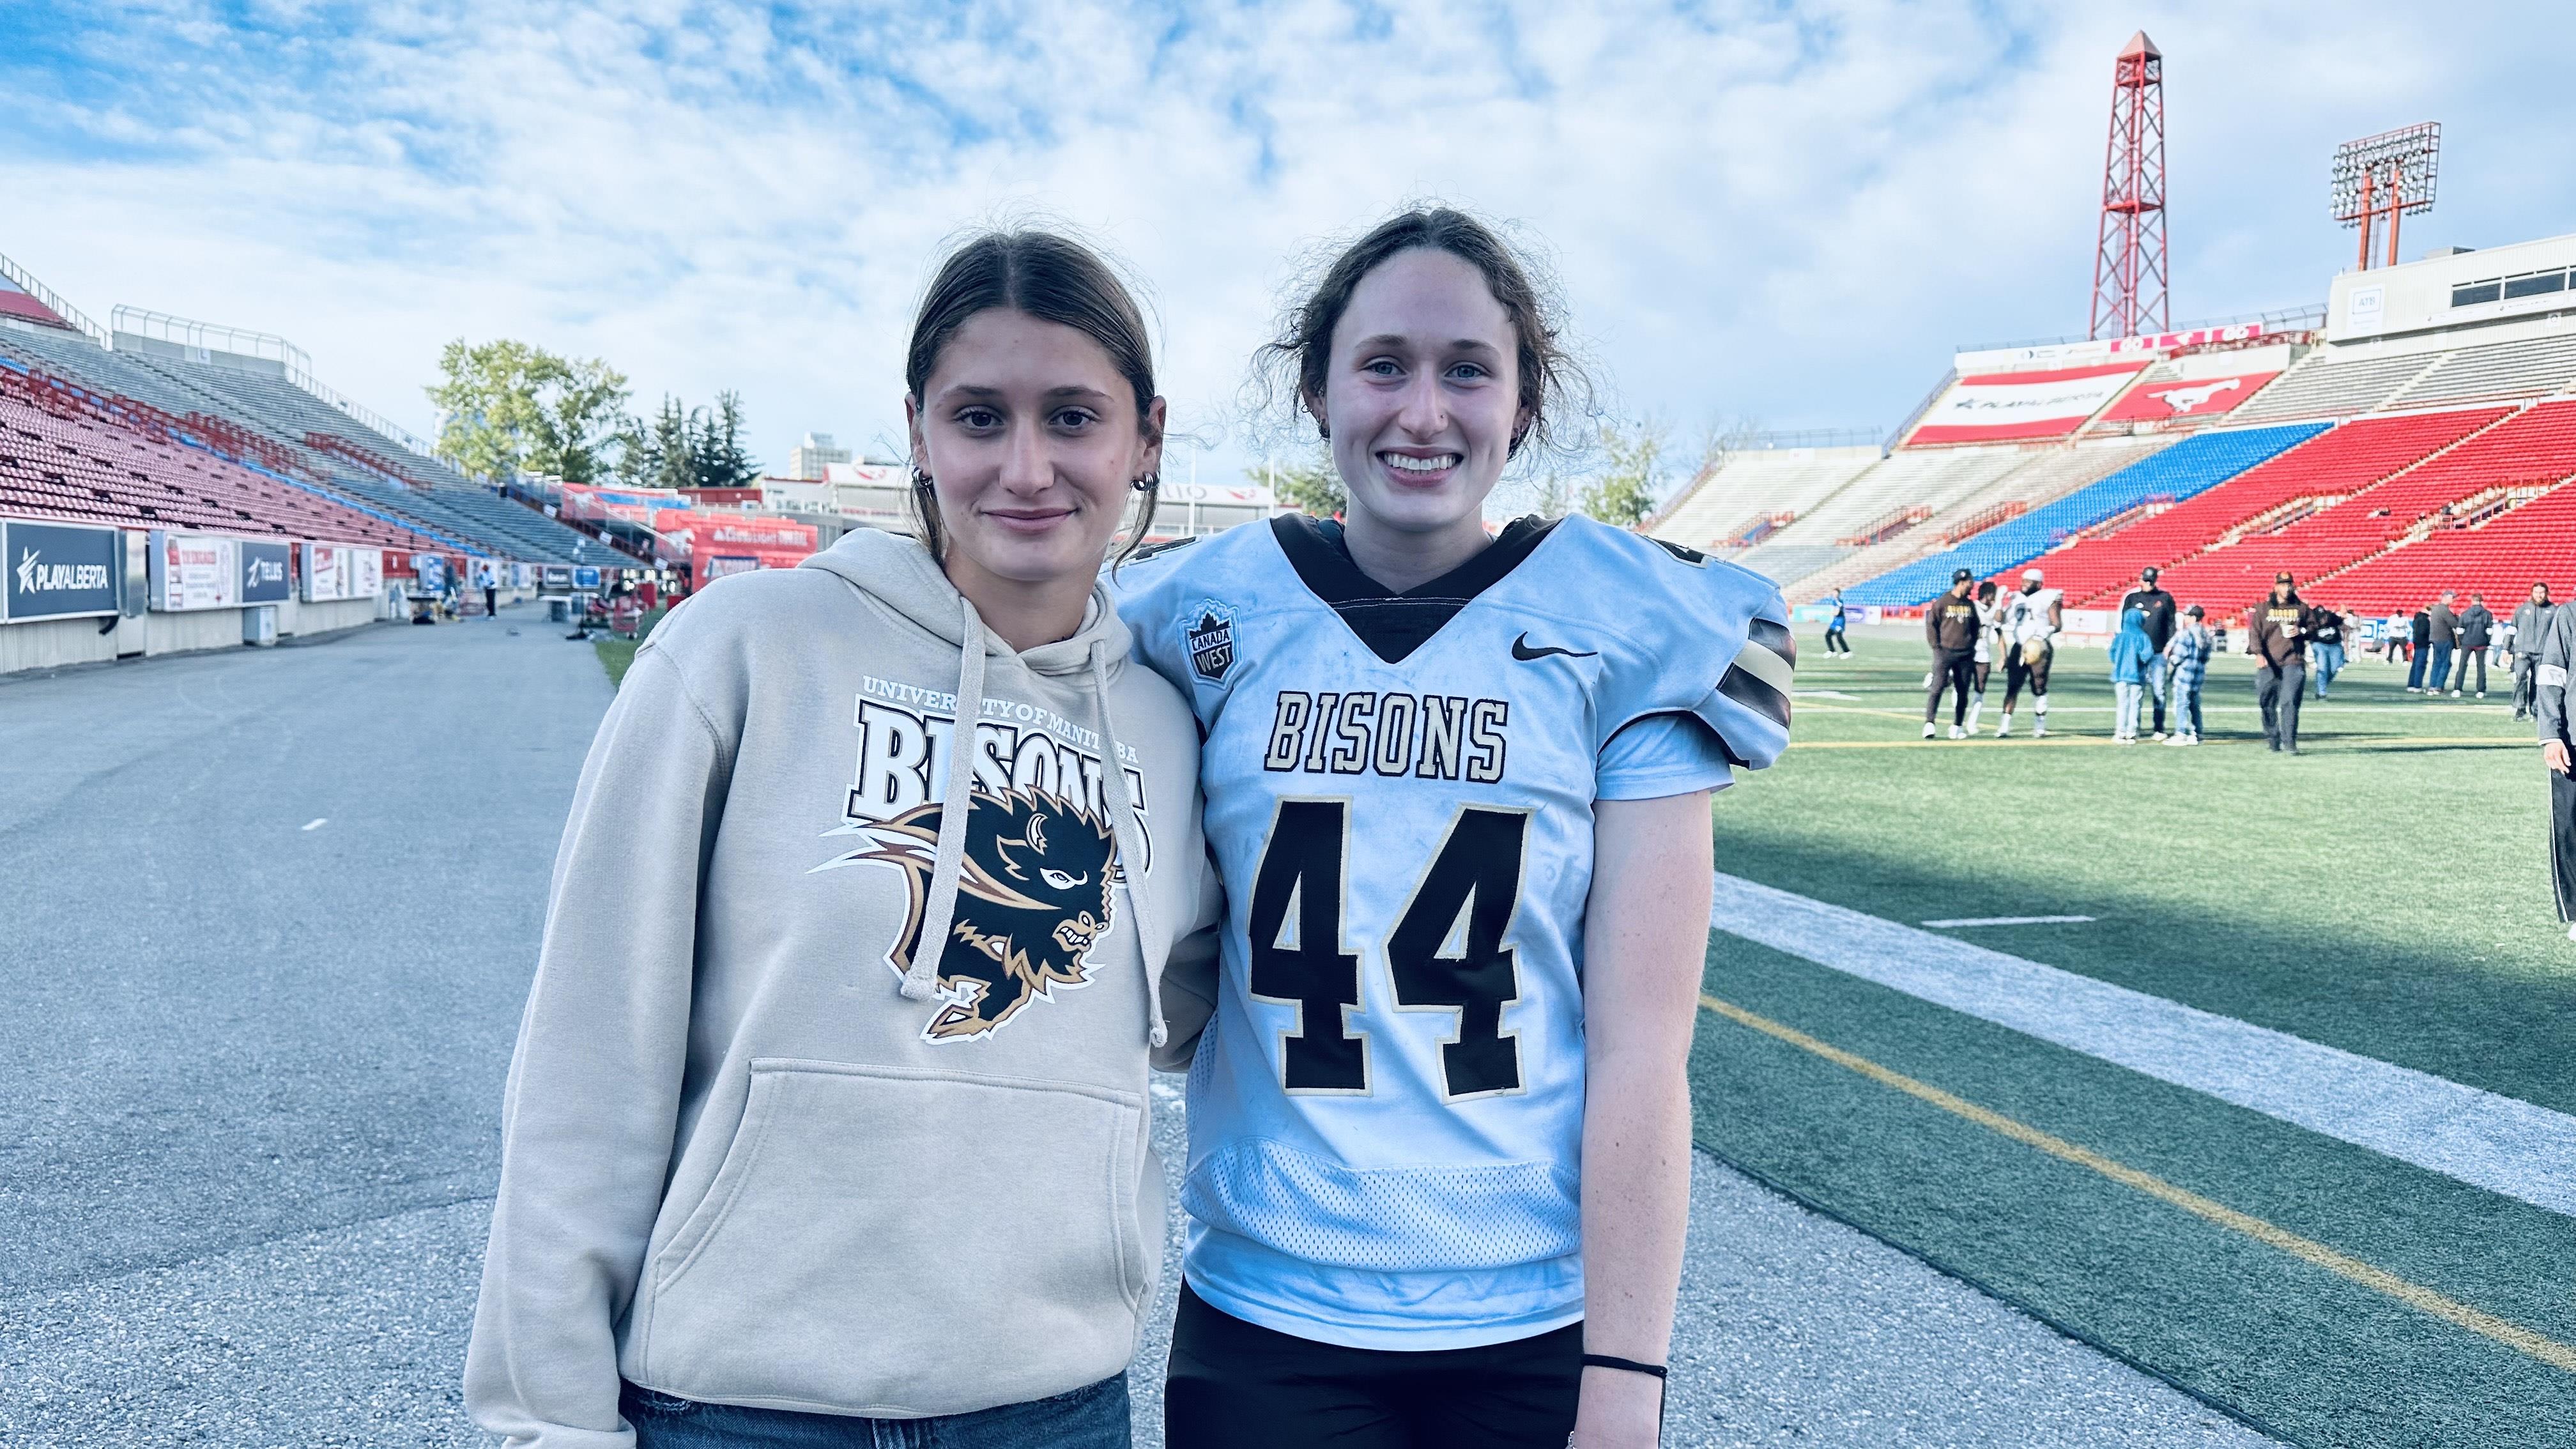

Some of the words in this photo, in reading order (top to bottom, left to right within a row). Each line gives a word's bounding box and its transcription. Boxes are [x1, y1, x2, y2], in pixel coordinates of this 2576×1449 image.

[36, 564, 109, 591] PLAYALBERTA
[1192, 629, 1230, 652] CANADA
[1197, 644, 1230, 673] WEST
[863, 675, 1015, 718] UNIVERTY
[1015, 703, 1047, 725] OF
[1046, 712, 1138, 764] MANITBA
[1264, 691, 1508, 783] BISONS
[1246, 794, 1534, 1104] 44
